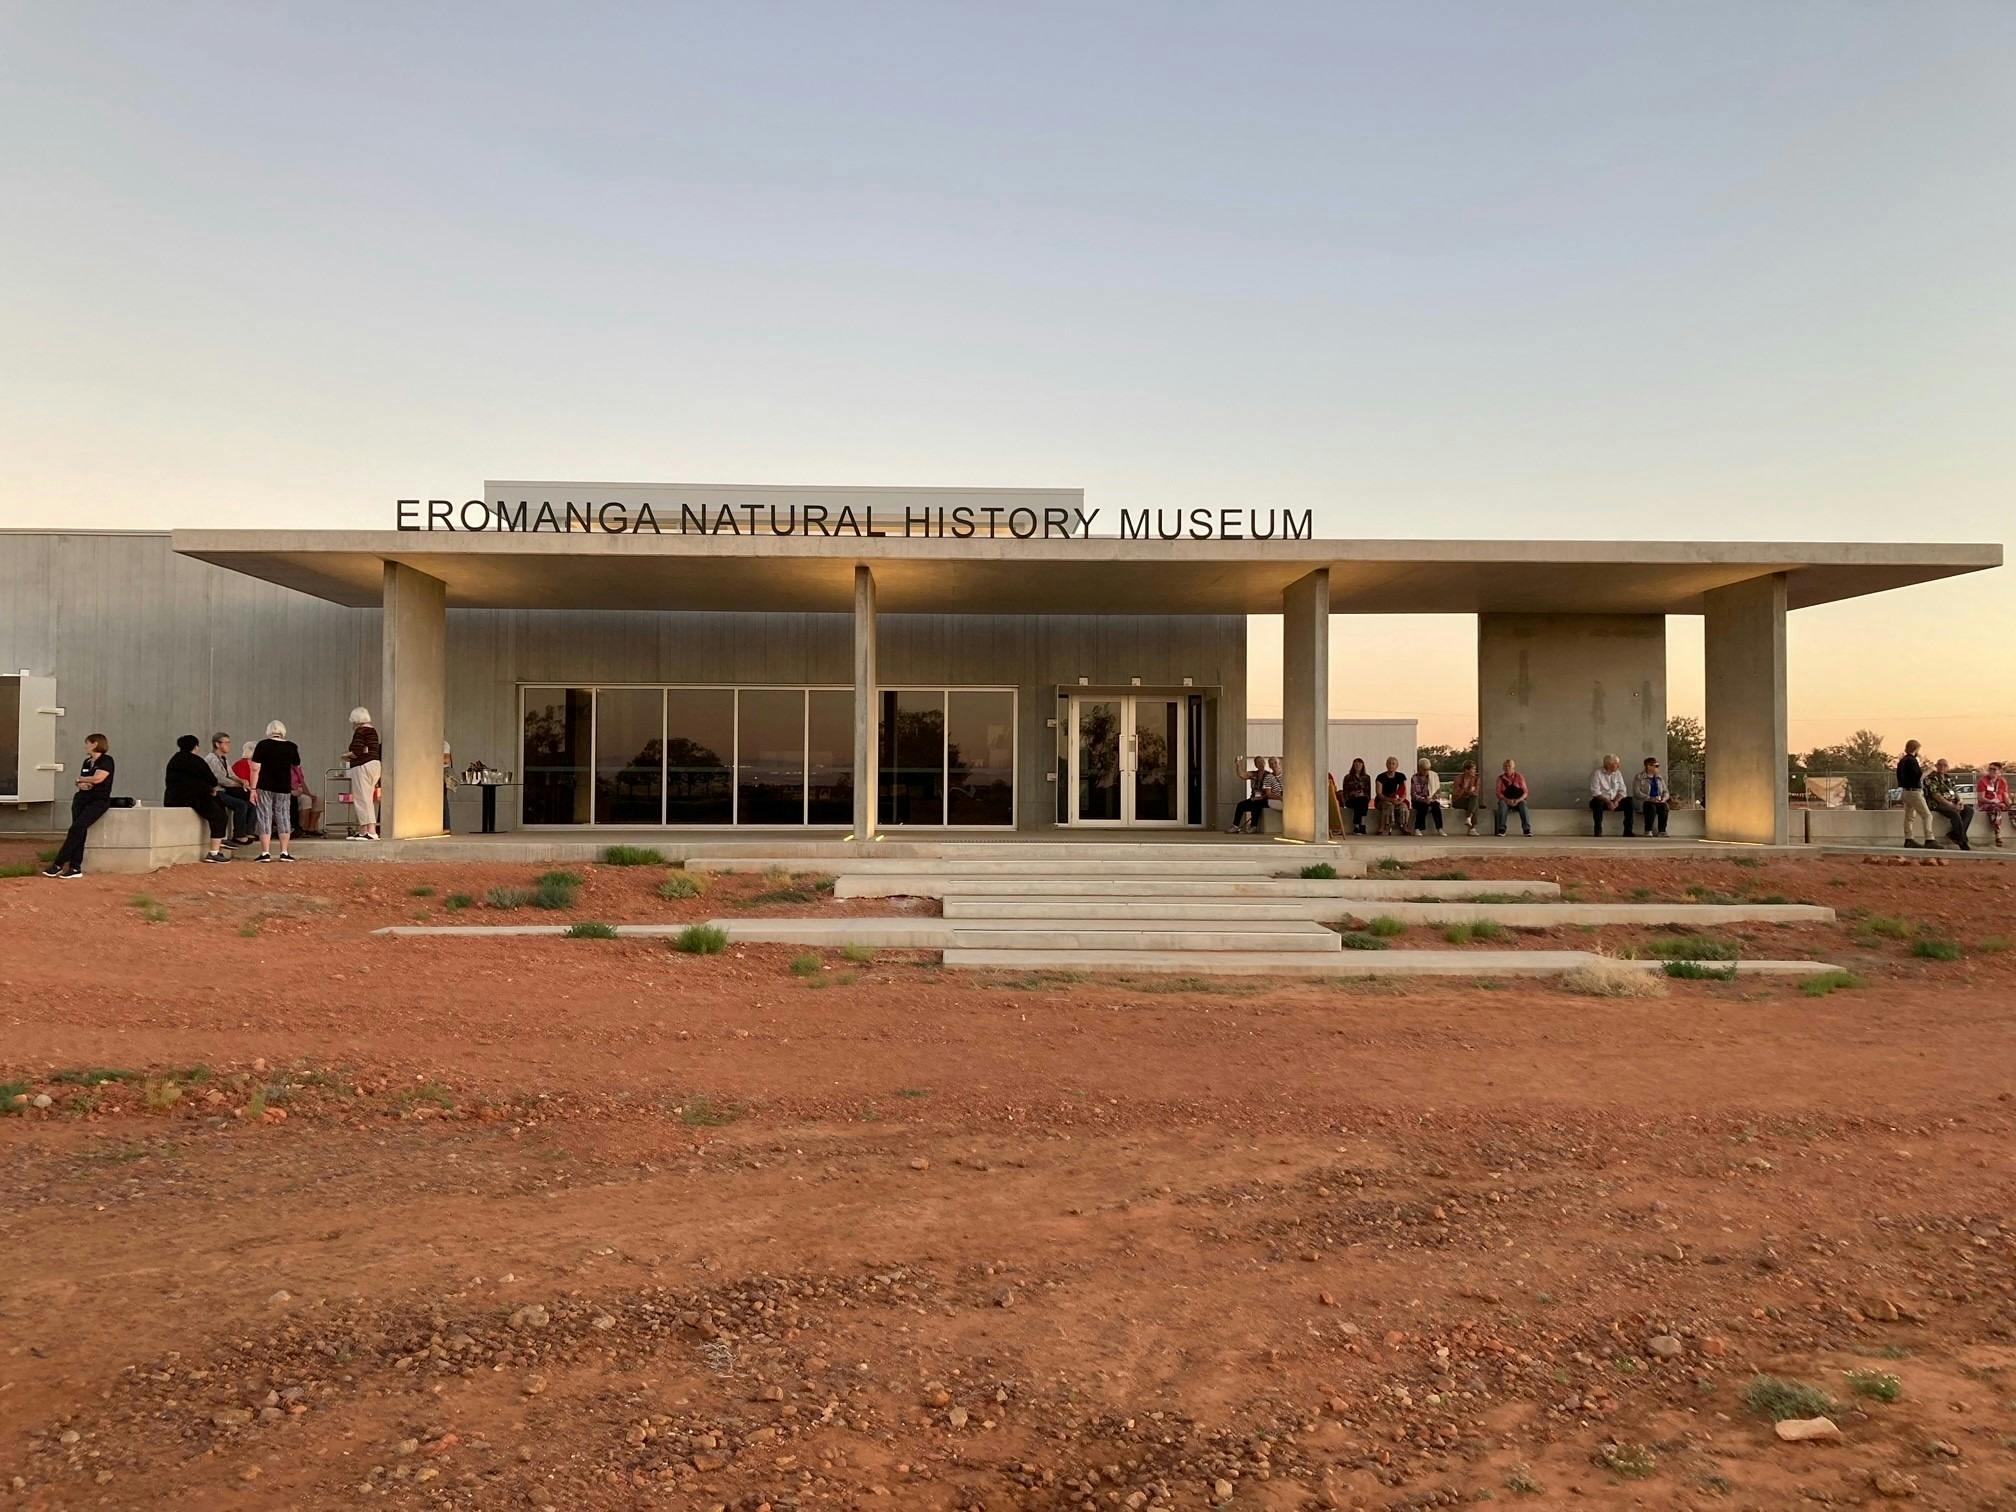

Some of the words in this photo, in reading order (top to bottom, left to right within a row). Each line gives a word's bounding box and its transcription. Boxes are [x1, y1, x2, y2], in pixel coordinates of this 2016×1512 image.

[397, 500, 661, 535] EROMANGA
[681, 503, 887, 538] NATURAL
[905, 506, 1101, 540] HISTORY
[1120, 508, 1312, 541] MUSEUM
